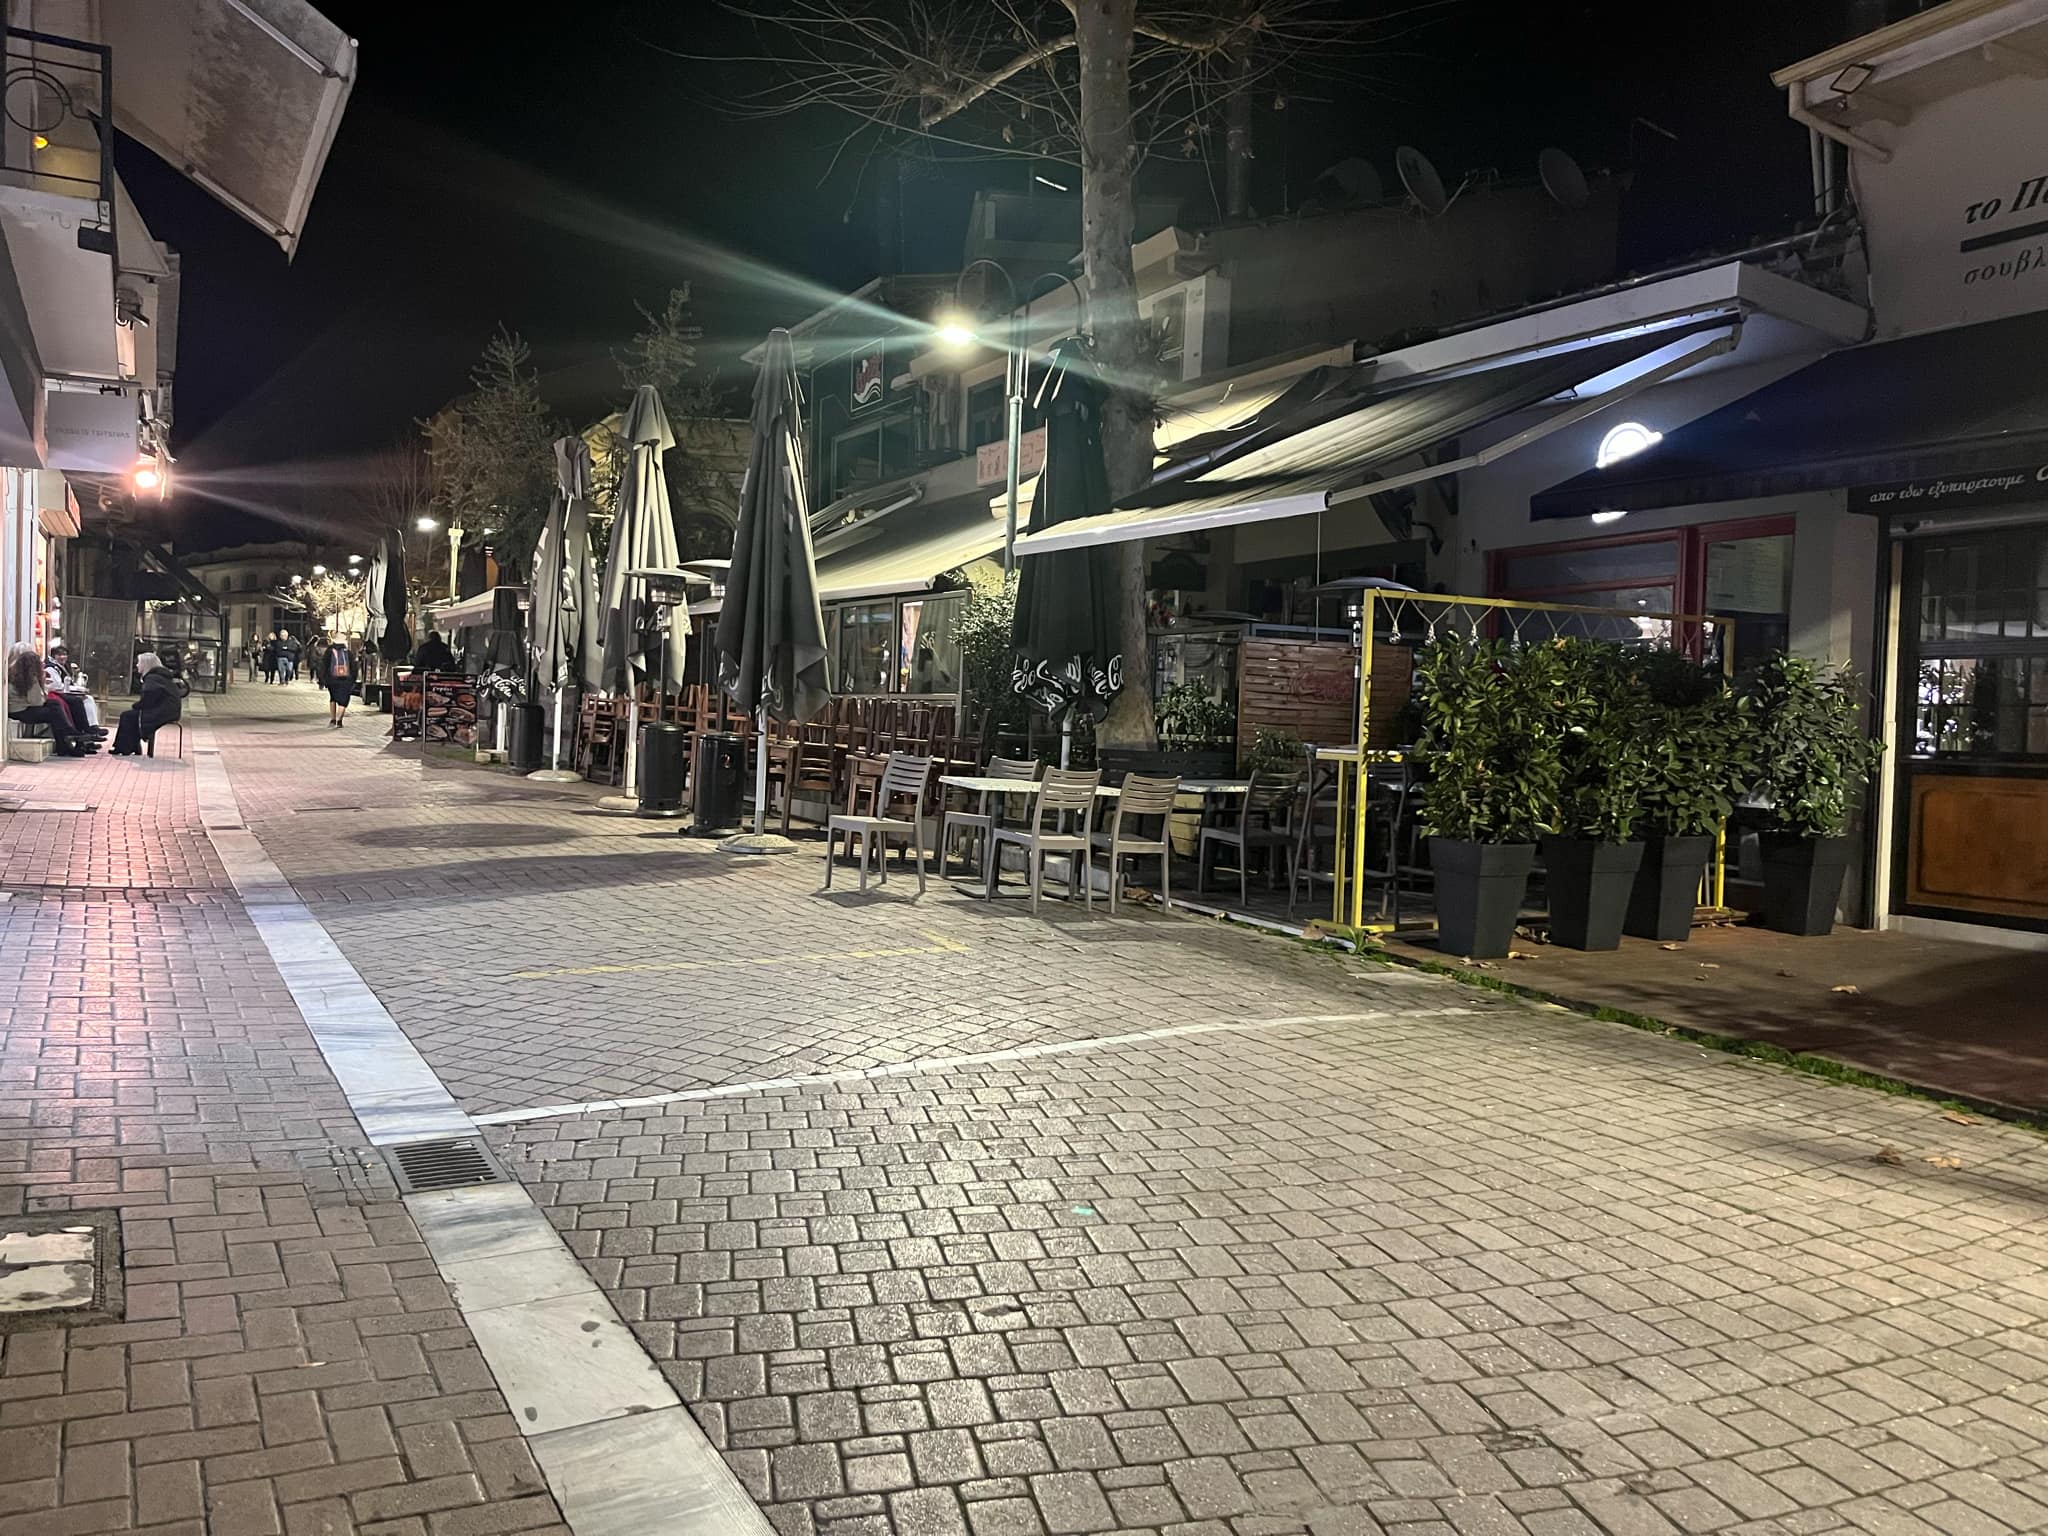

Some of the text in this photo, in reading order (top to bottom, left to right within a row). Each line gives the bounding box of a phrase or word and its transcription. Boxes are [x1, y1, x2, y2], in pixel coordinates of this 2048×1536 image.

[1965, 175, 2048, 224] το Π
[1964, 245, 2047, 285] σουβλ
[1869, 490, 1896, 504] απο
[1899, 482, 1925, 500] εδω
